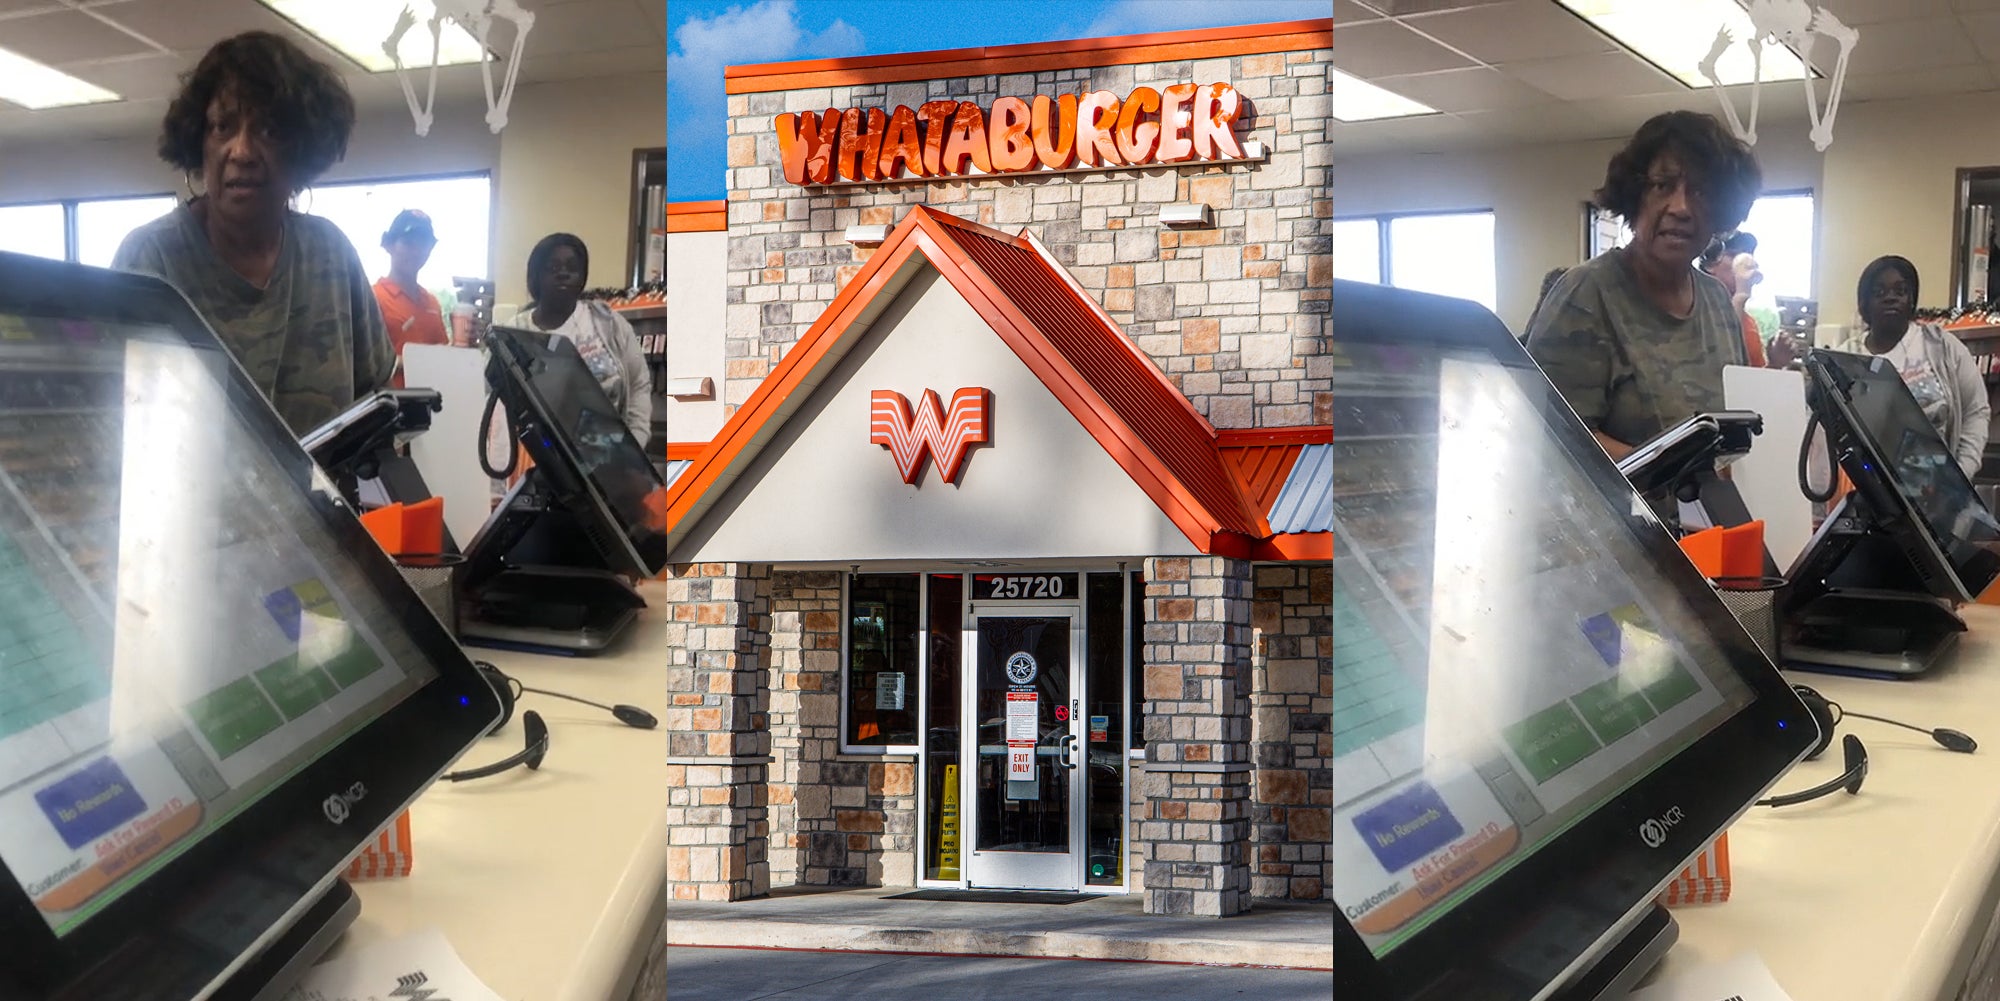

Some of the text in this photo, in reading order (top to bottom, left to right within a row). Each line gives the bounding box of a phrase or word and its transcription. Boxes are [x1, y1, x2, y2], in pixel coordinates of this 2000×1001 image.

[775, 82, 1245, 186] WHATABURGER
[991, 576, 1063, 598] 25720
[1013, 753, 1029, 762] EXIT
[1013, 763, 1029, 773] ONLY
[57, 808, 77, 824] No
[1375, 808, 1440, 848] No Rewards
[1659, 805, 1685, 831] NCR
[1412, 862, 1431, 882] Ask
[1430, 852, 1451, 870] For
[1485, 820, 1500, 836] ID
[1345, 881, 1403, 919] Customer:
